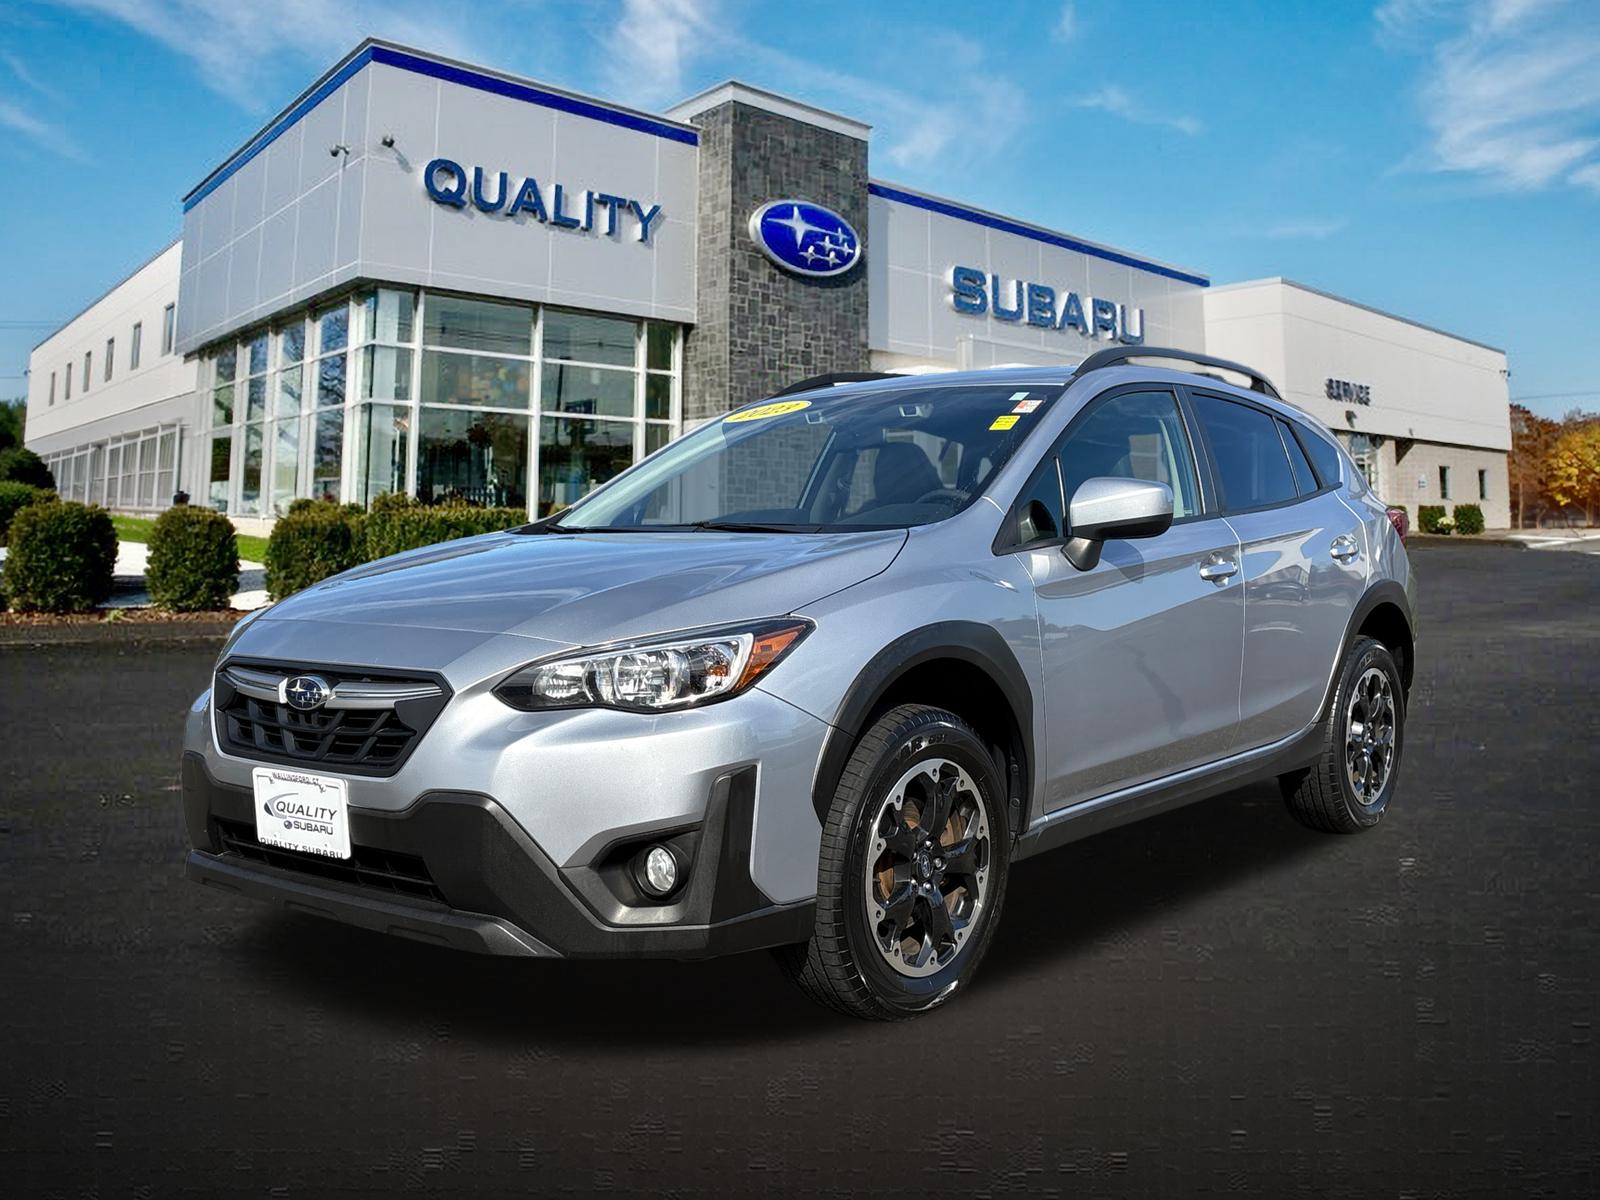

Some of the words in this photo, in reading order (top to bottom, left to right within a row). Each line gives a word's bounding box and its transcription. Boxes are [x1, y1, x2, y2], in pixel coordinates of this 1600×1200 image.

[424, 158, 661, 242] QUALITY
[952, 265, 1145, 345] SUBARU
[276, 801, 337, 819] QUALITY
[294, 821, 333, 834] SUBARU
[261, 837, 298, 850] QUALITY
[302, 846, 342, 858] SUBARU
